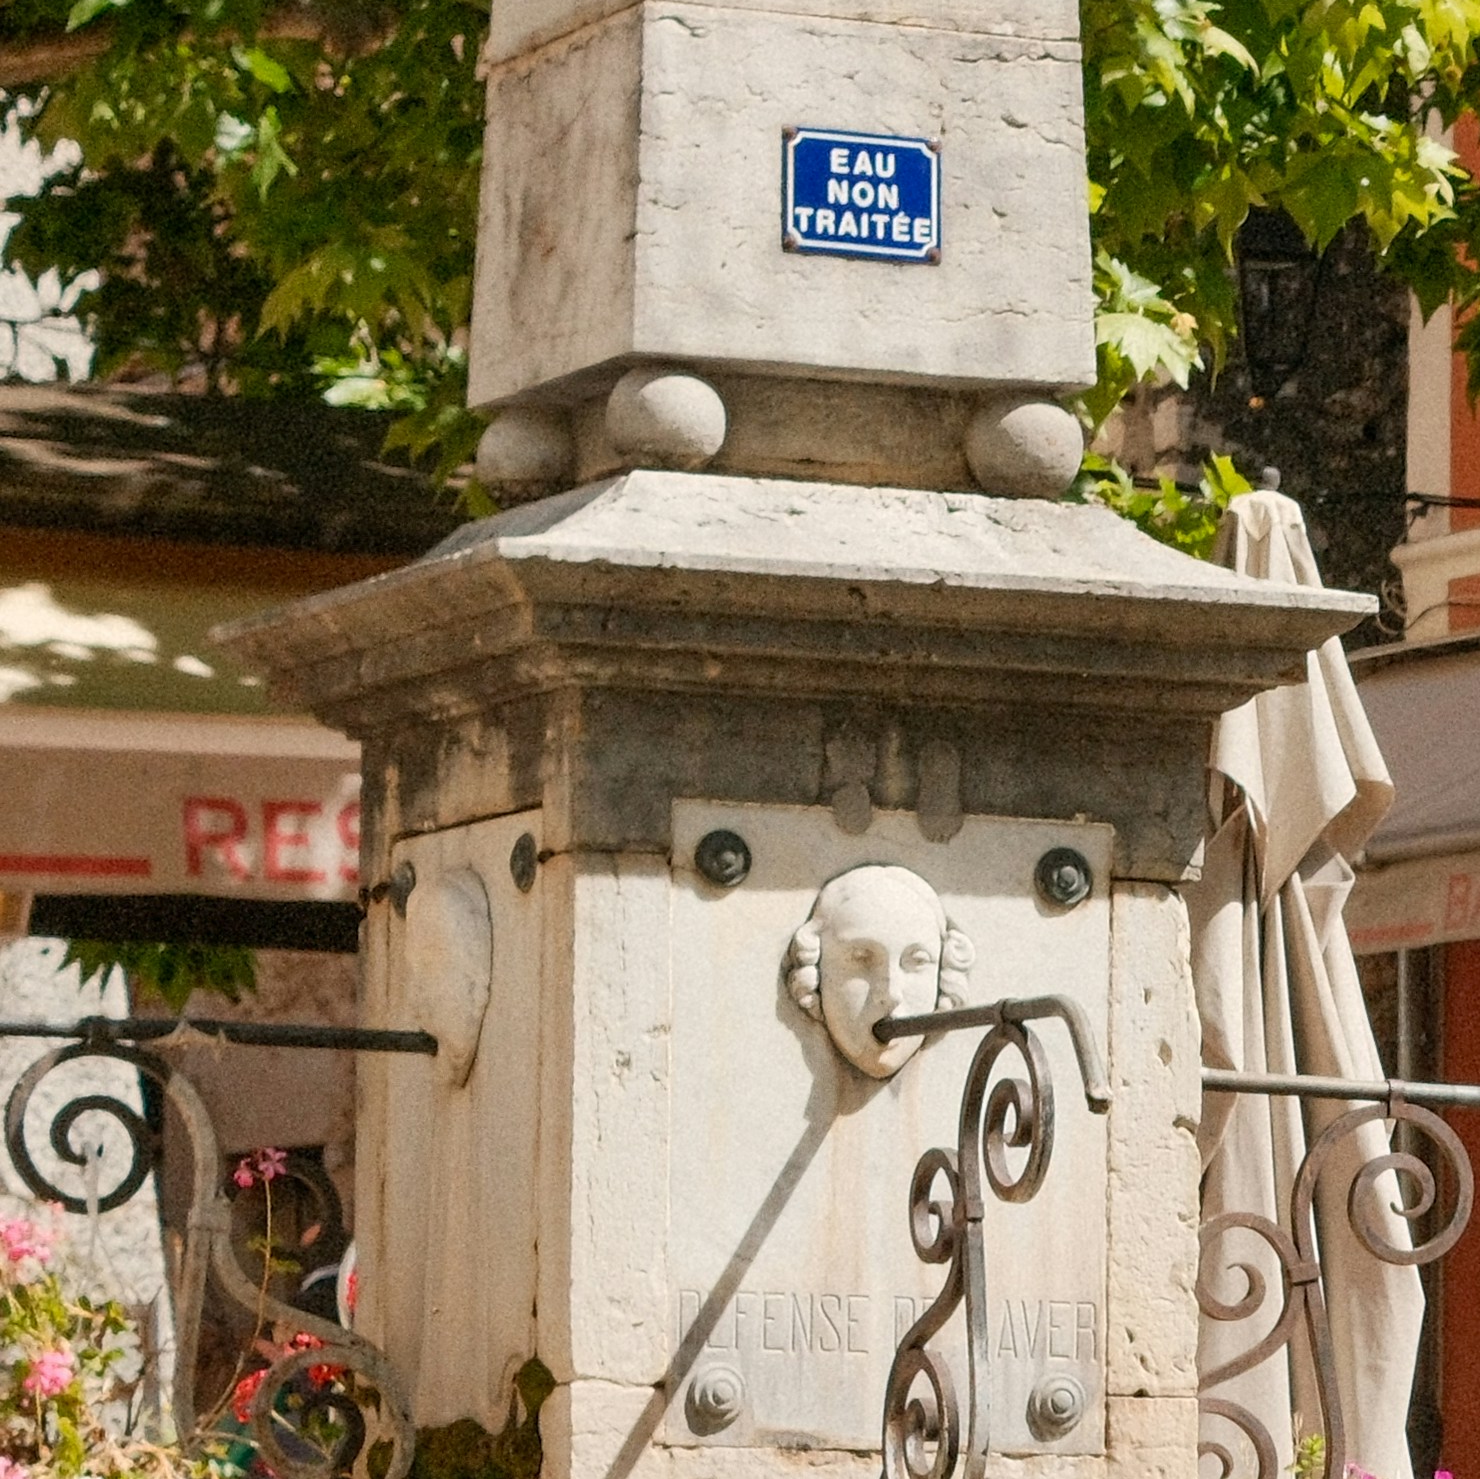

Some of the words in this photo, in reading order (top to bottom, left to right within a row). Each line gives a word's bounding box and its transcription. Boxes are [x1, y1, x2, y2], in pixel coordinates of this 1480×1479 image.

[829, 147, 896, 179] EAU
[827, 178, 899, 210] NON
[794, 206, 931, 244] TRAITÉE
[997, 1298, 1099, 1362] AVER
